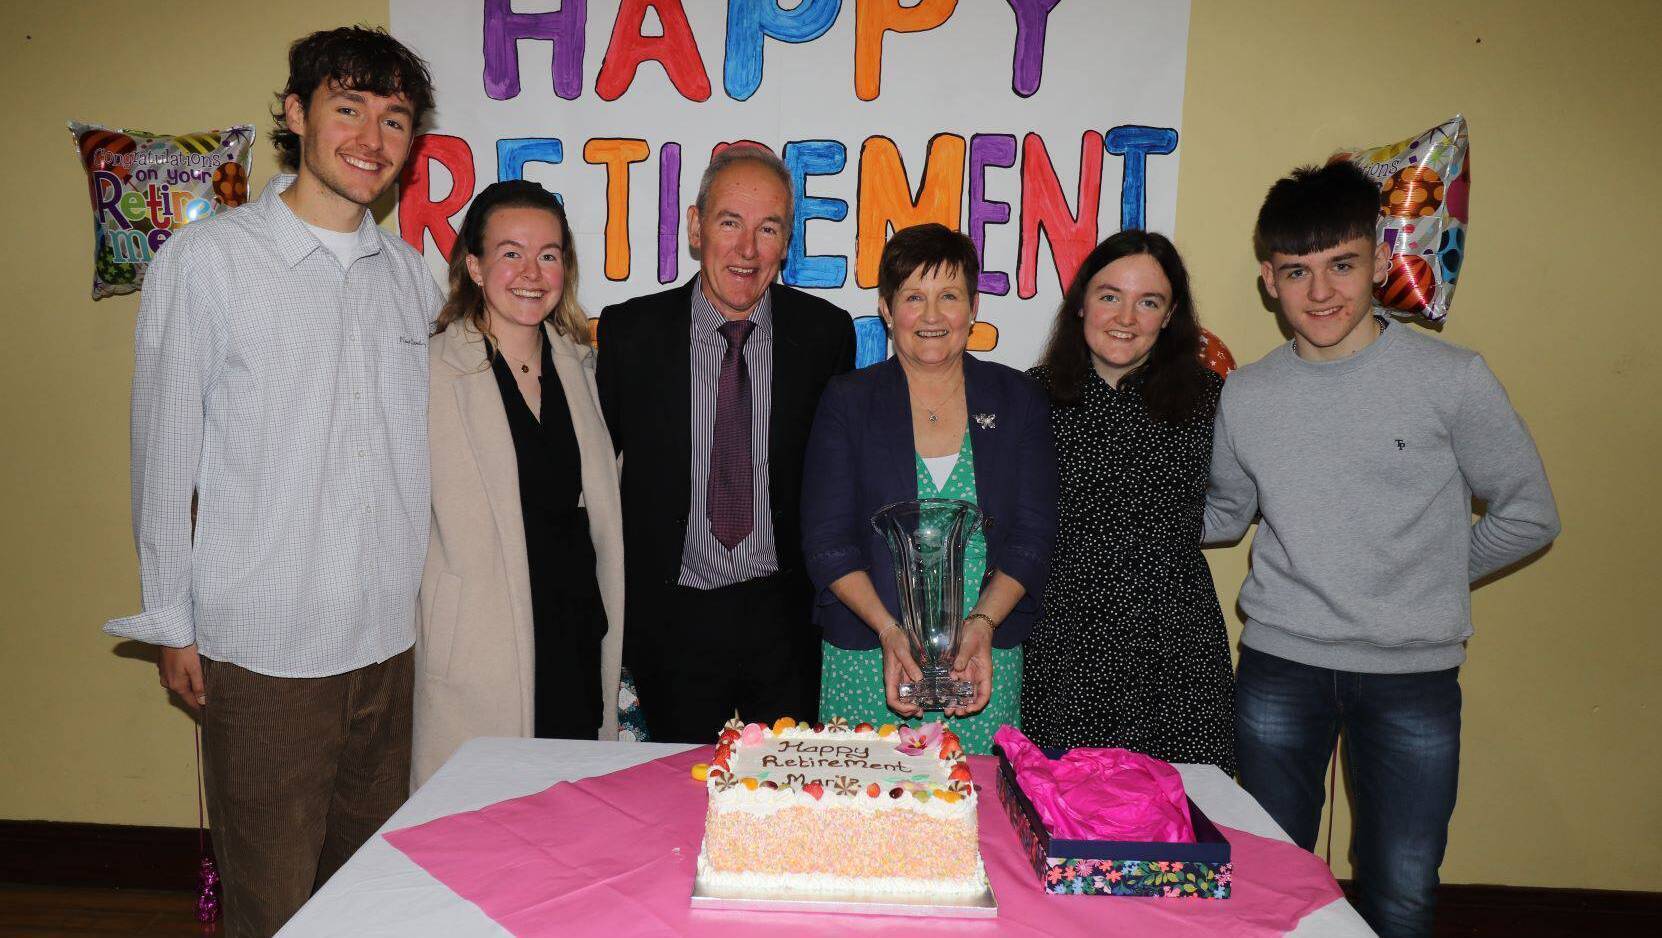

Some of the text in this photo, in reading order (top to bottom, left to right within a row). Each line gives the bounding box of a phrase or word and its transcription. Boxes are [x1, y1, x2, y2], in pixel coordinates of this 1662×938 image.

[94, 148, 221, 168] Congratulations
[135, 169, 212, 185] on your
[94, 170, 212, 229] Retire
[778, 741, 869, 758] Happy
[762, 755, 912, 773] Retirement
